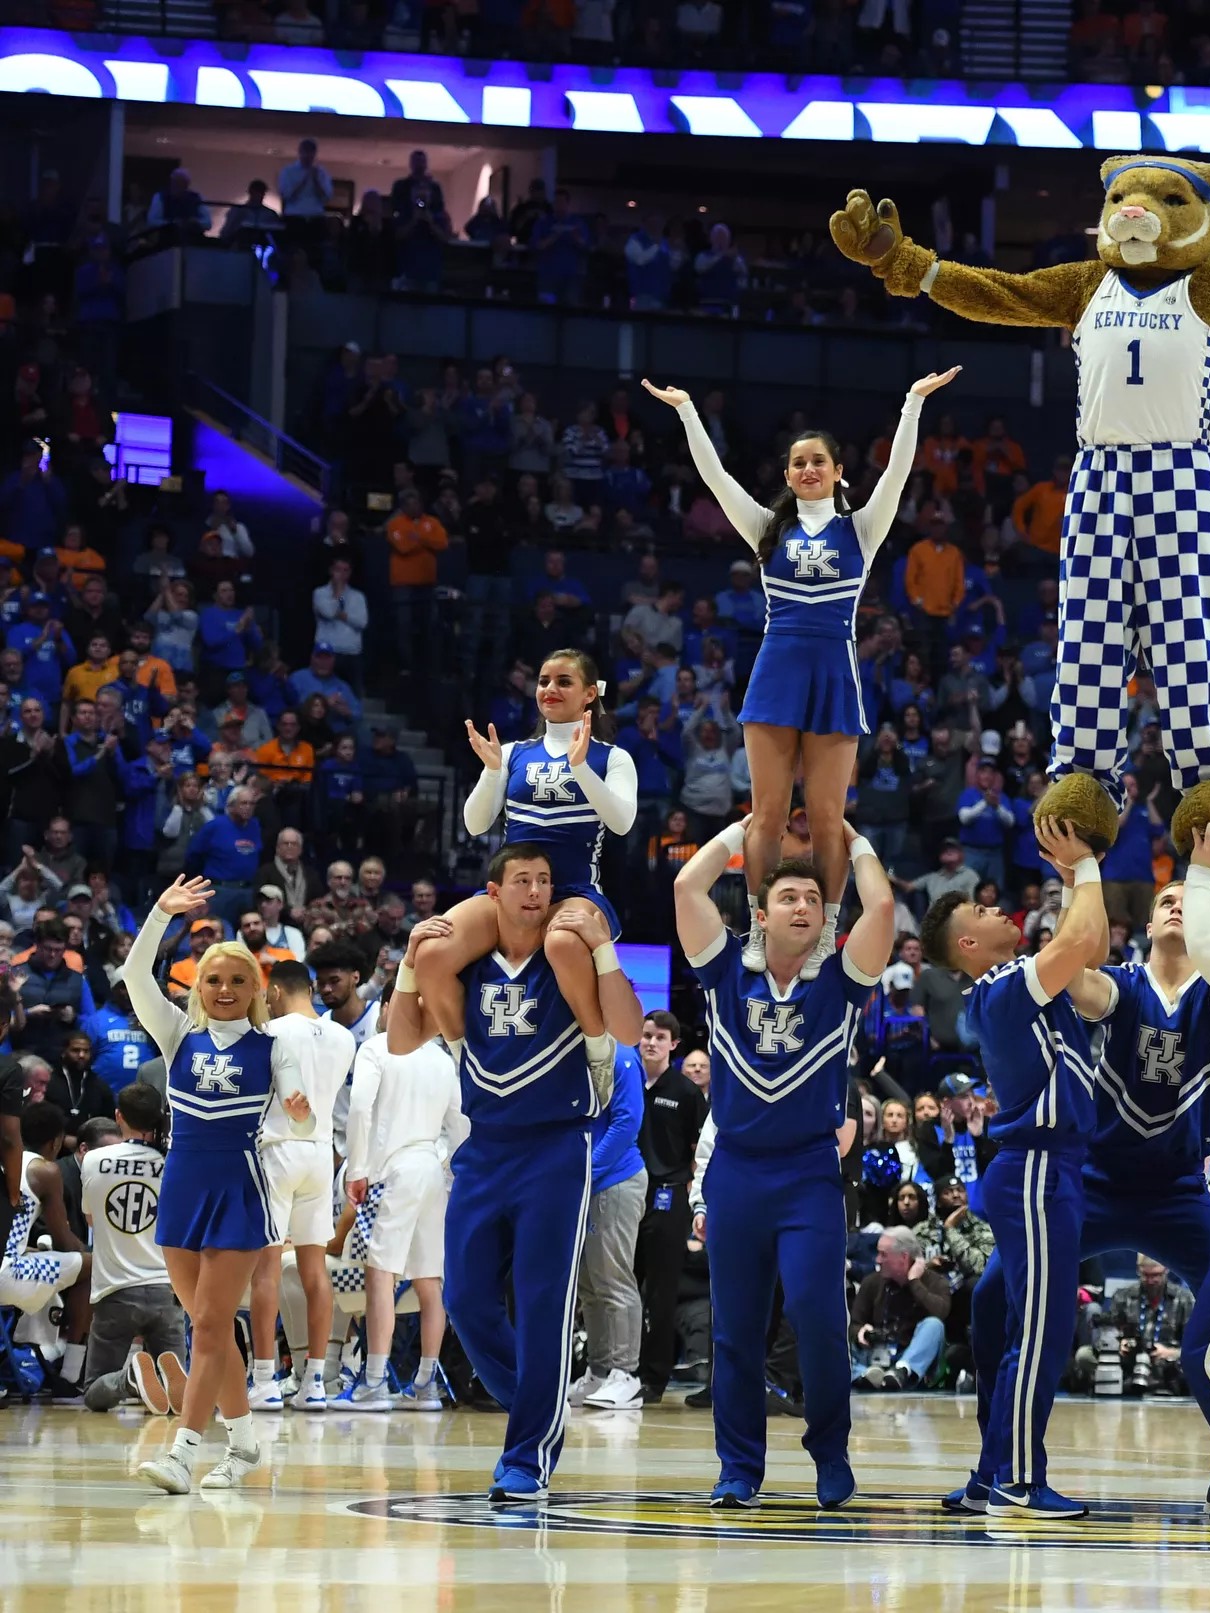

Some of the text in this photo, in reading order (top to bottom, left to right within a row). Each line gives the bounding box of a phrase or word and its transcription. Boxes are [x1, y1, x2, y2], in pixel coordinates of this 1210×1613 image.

[1094, 311, 1182, 330] KENTUCKY
[1126, 339, 1144, 385] 1
[786, 540, 840, 579] UK
[525, 761, 576, 802] UK
[480, 983, 538, 1036] UK
[746, 998, 804, 1053] UK
[123, 1045, 139, 1069] 2
[191, 1053, 243, 1094] UK
[1136, 1024, 1186, 1085] UK
[107, 1183, 158, 1233] SEC
